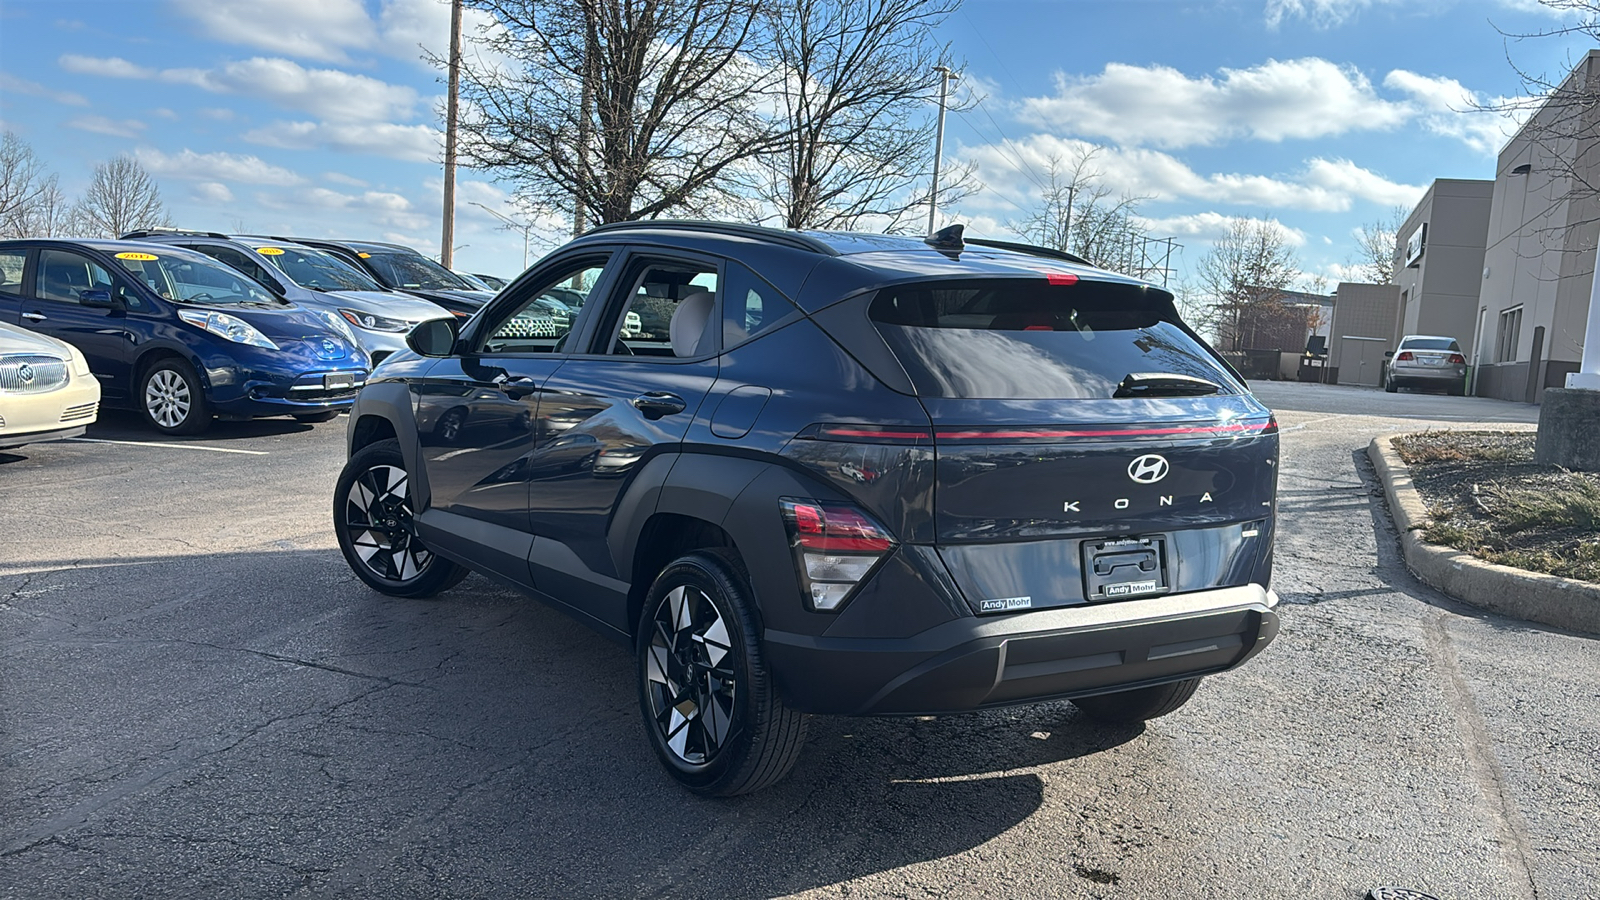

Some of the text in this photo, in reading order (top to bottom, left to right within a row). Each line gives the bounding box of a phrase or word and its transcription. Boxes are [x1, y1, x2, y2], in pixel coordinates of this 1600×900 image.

[1063, 491, 1213, 513] KONA
[1108, 584, 1154, 595] Andy Mohr
[982, 598, 1030, 609] Andy Mohr
